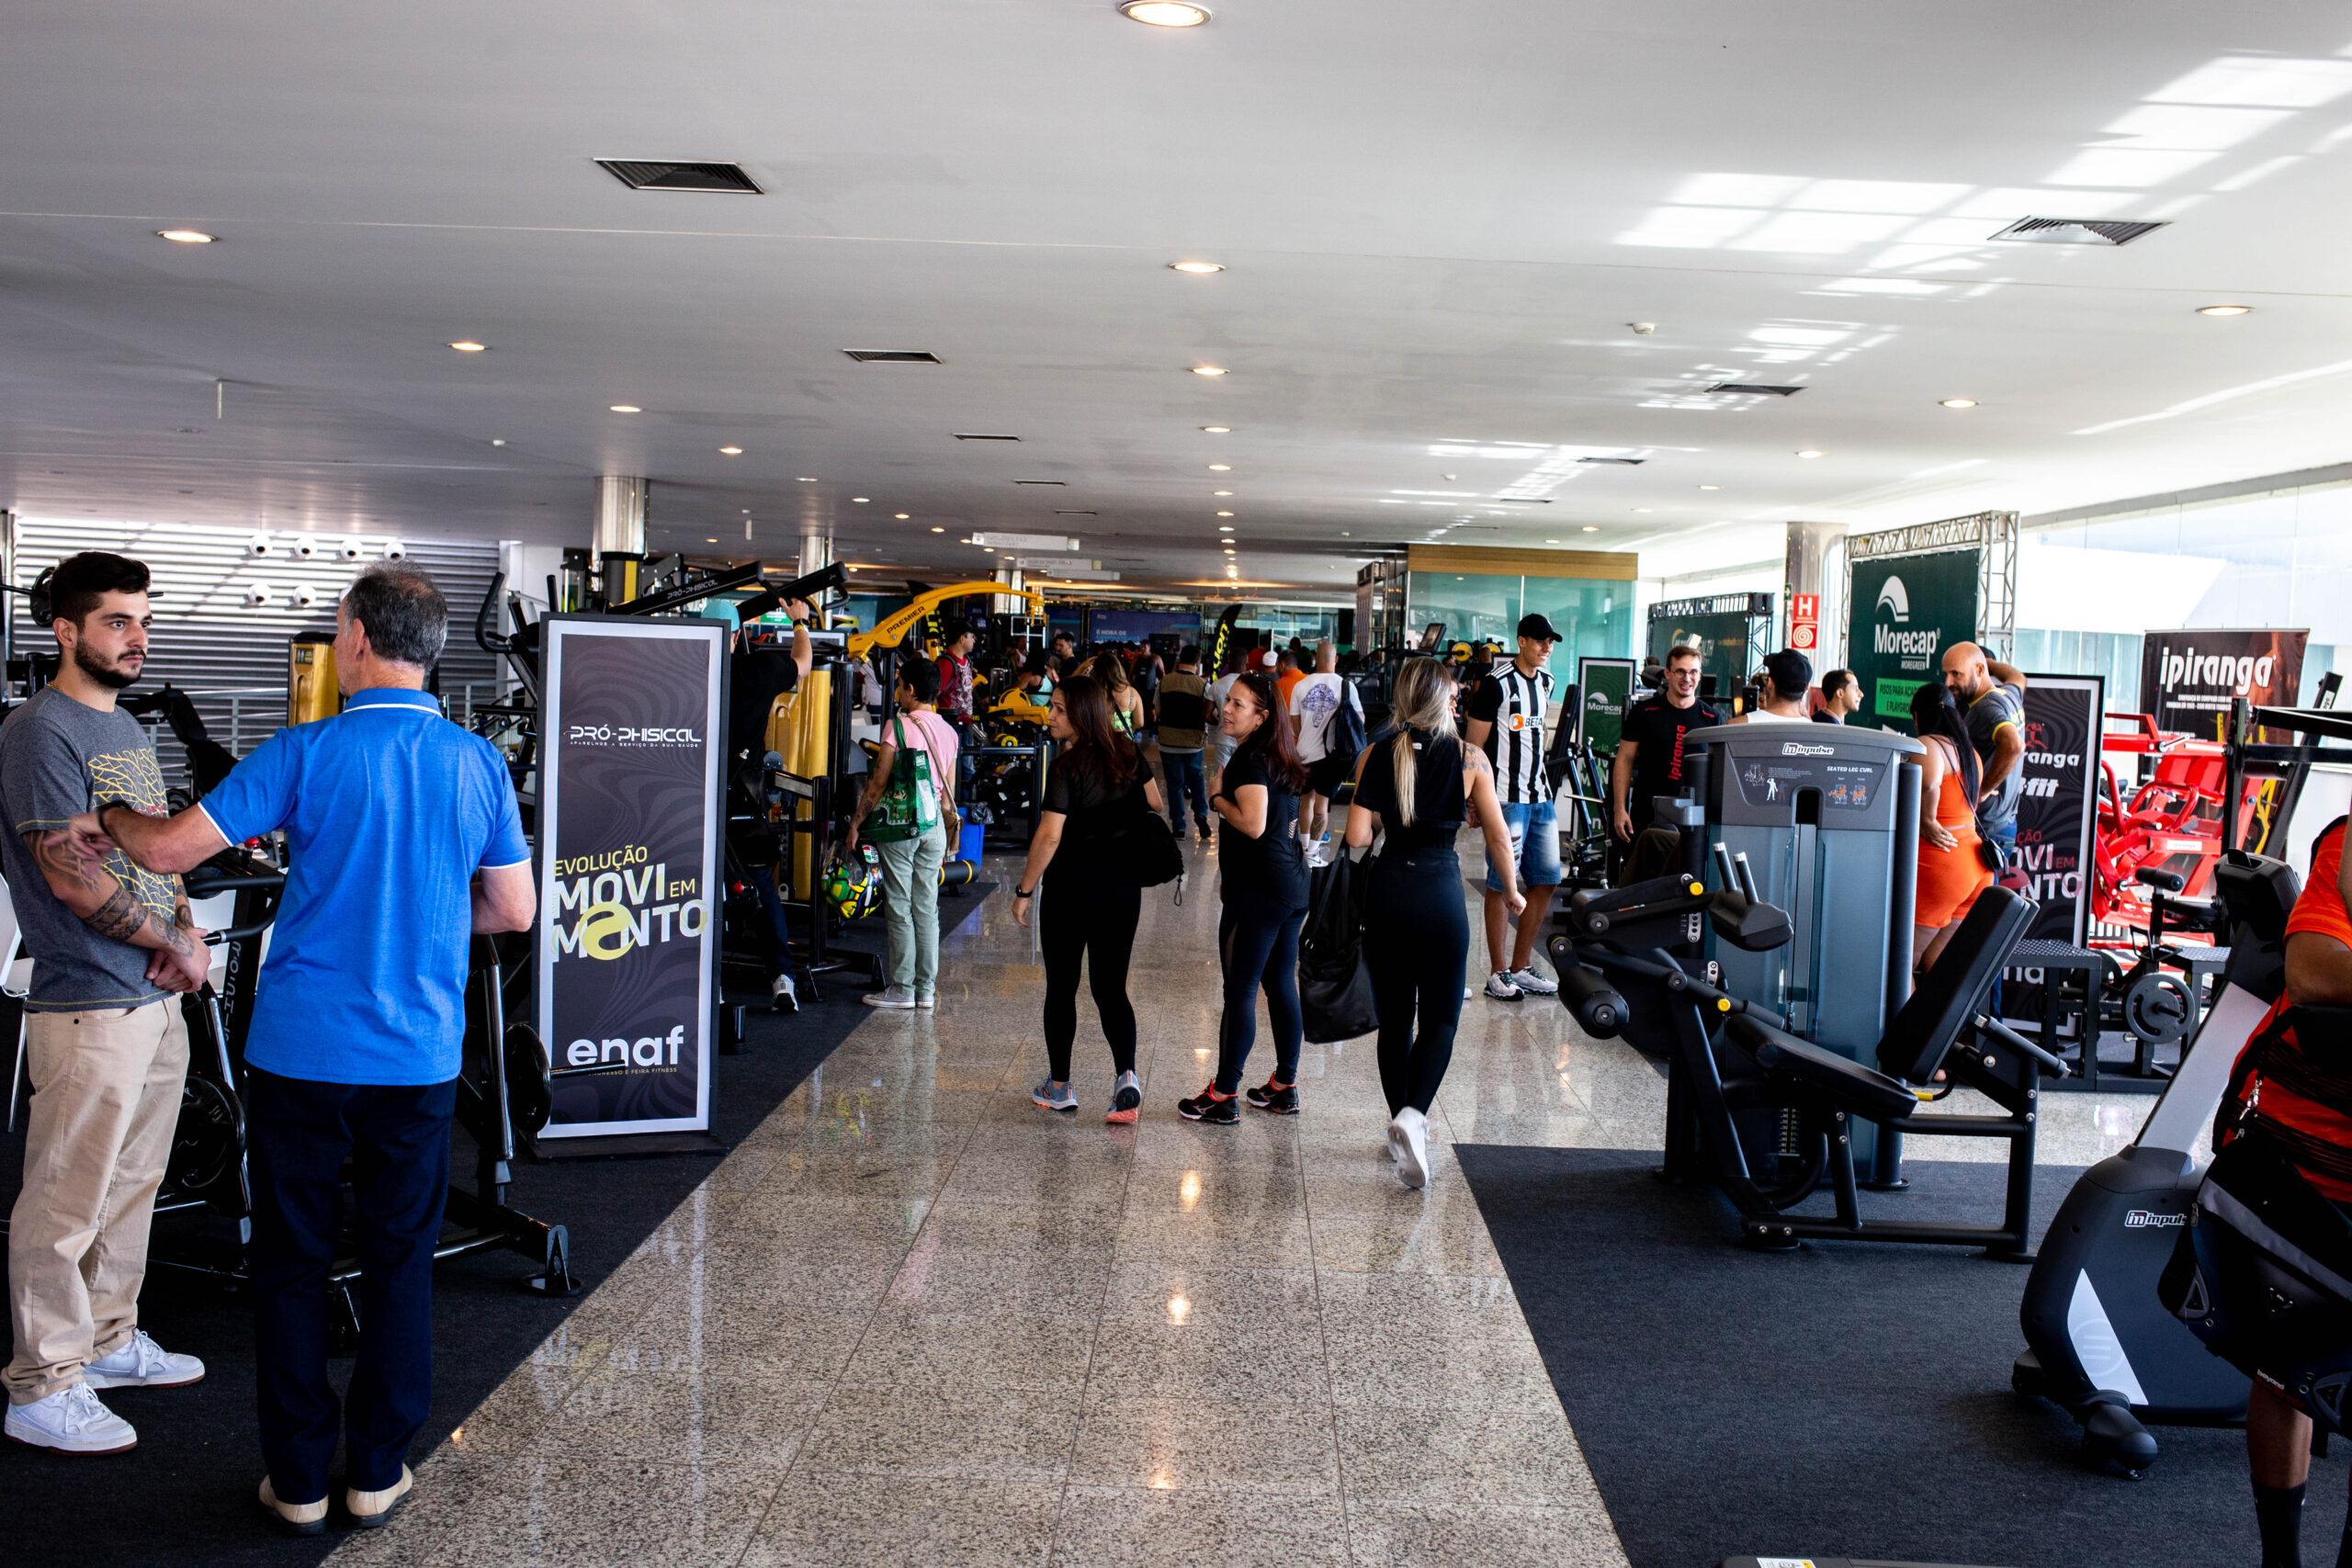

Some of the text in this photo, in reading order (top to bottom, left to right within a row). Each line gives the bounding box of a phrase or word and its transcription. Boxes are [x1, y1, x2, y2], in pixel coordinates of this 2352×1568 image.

[887, 605, 925, 634] PREMIER
[1798, 597, 1813, 615] H
[2160, 647, 2273, 695] ipiranga
[571, 724, 702, 743] PRÓ-PHISICAL
[554, 844, 648, 876] EVOLUÇÃO
[2055, 856, 2075, 869] EM
[551, 863, 695, 919] MOVI EM
[567, 1025, 684, 1066] enaf
